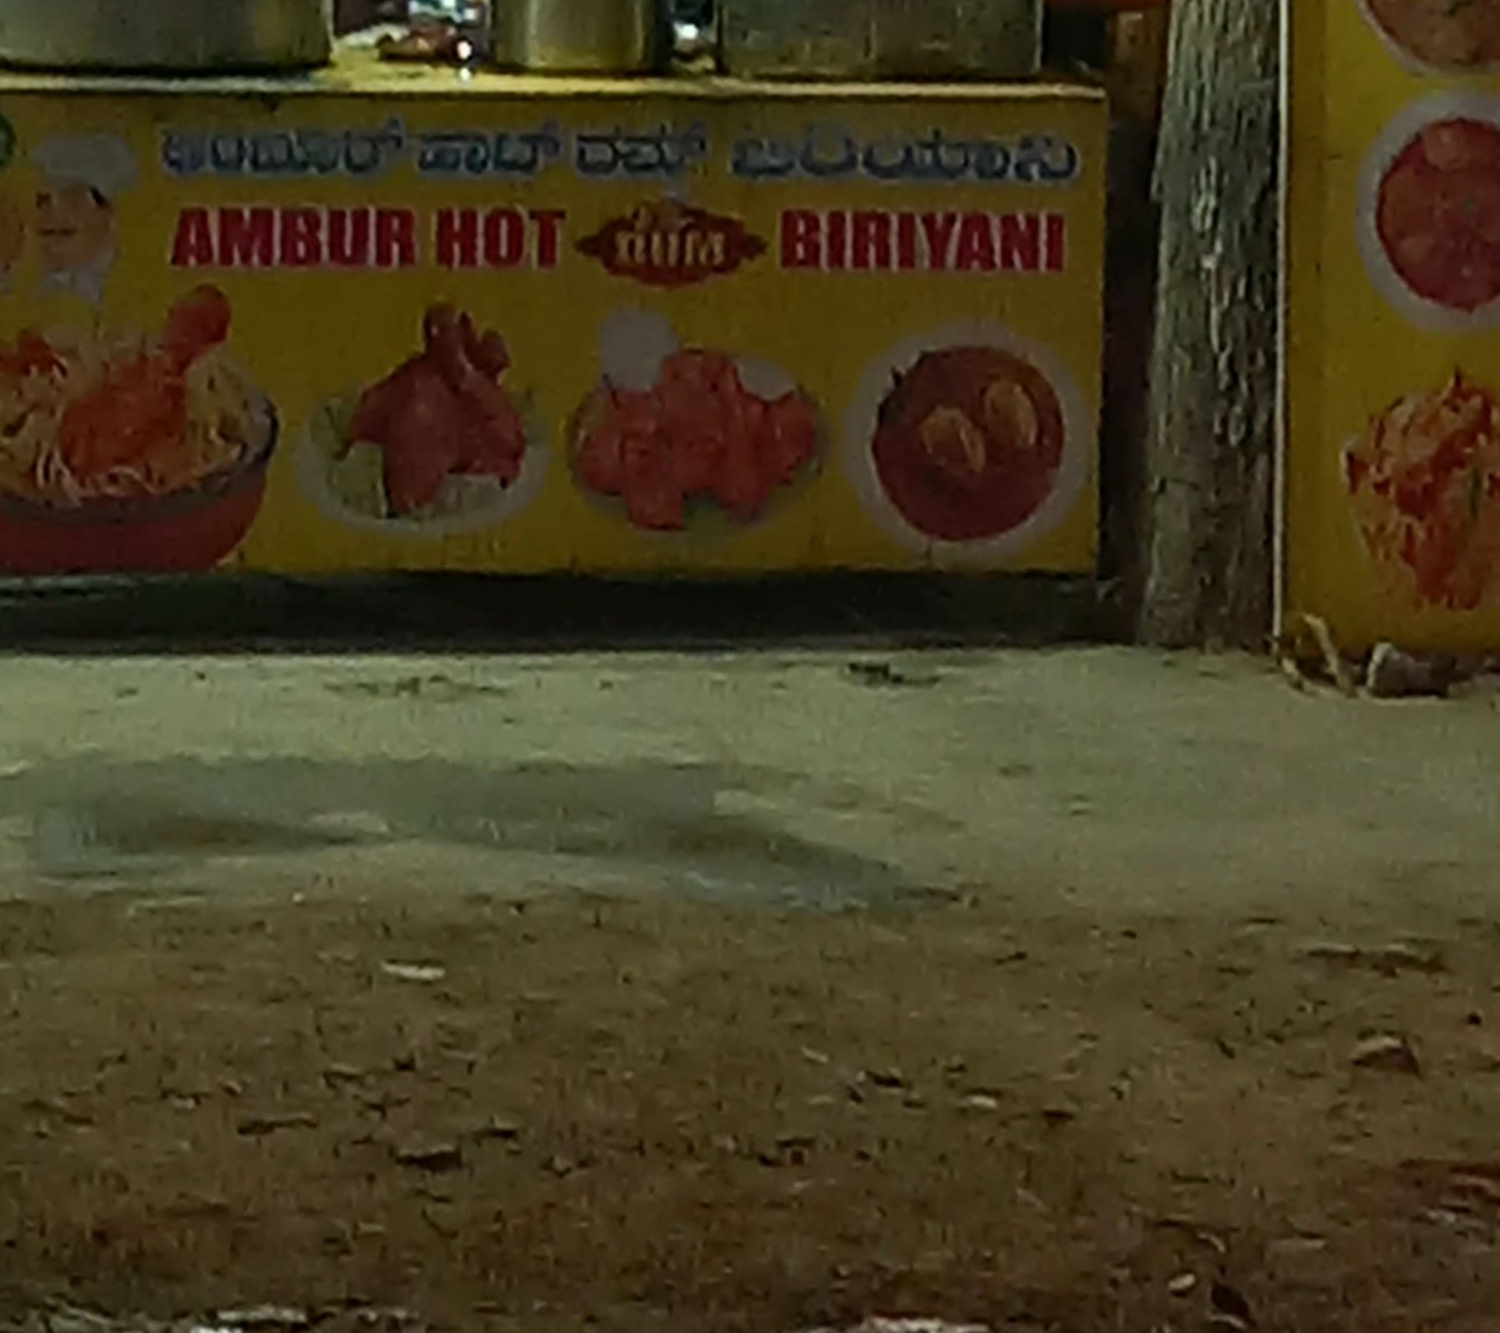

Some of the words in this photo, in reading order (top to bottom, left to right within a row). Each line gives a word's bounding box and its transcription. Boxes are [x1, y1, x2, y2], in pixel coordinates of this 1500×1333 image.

[170, 206, 417, 268] AMBUR
[434, 206, 568, 270] HOT
[779, 208, 1067, 273] BIRIYANI
